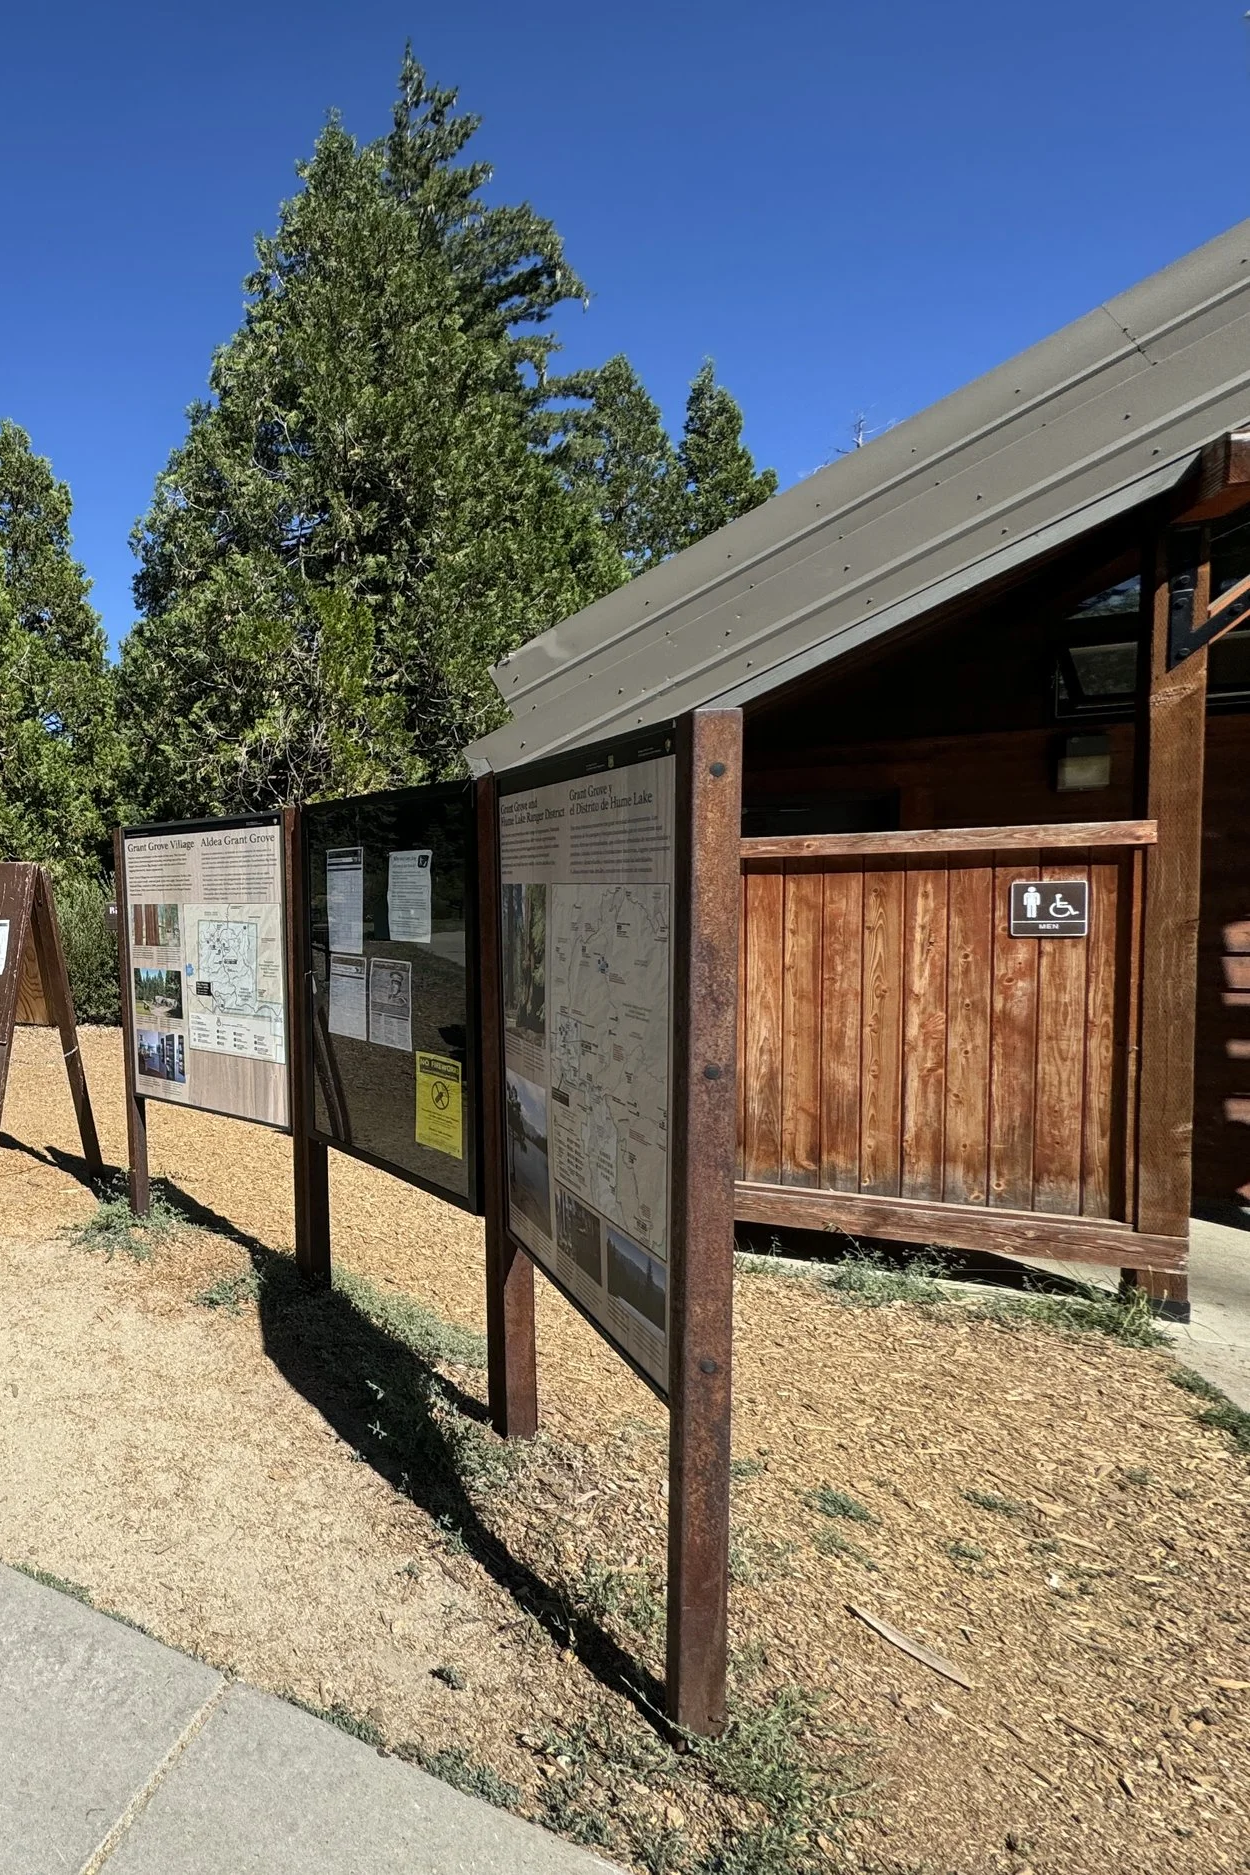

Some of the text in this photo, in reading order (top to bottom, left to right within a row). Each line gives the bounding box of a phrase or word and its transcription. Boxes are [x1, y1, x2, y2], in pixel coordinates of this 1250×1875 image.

[569, 788, 586, 800] Grant
[588, 786, 606, 797] Grove
[570, 790, 652, 816] el Distrito de Hume Lake
[545, 807, 565, 819] District
[128, 840, 194, 852] Grant Grove Village
[200, 834, 275, 847] Aldea Grant Grove
[420, 1058, 430, 1066] NO
